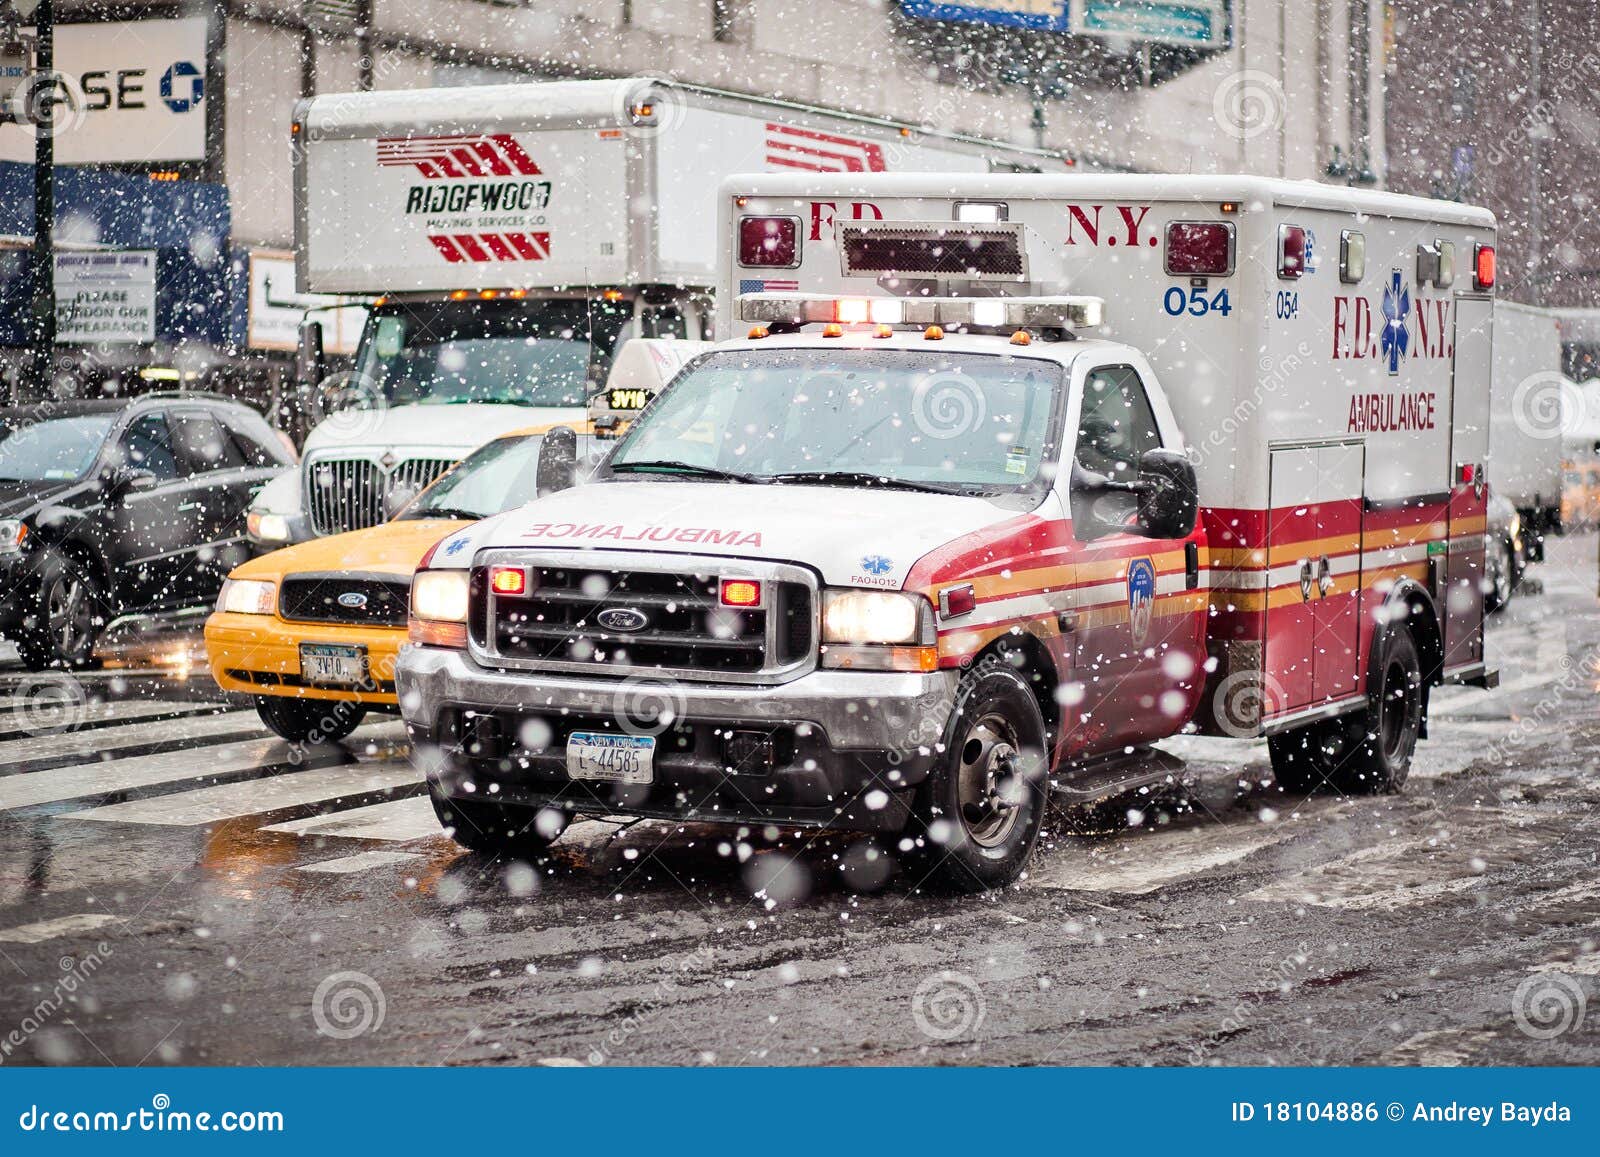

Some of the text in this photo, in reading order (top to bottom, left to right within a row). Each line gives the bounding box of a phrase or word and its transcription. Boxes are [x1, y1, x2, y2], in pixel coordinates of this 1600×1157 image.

[405, 181, 552, 213] RIDGEWOOD
[426, 218, 472, 228] MOVING
[479, 216, 525, 227] SERVICES
[1064, 205, 1158, 247] N.Y.
[77, 290, 128, 303] PLEASE
[1163, 286, 1232, 317] 054
[1276, 290, 1299, 320] 054
[1332, 296, 1454, 360] F.D. N.Y.
[611, 390, 646, 409] 3V10
[1346, 391, 1436, 433] AMBULANCE
